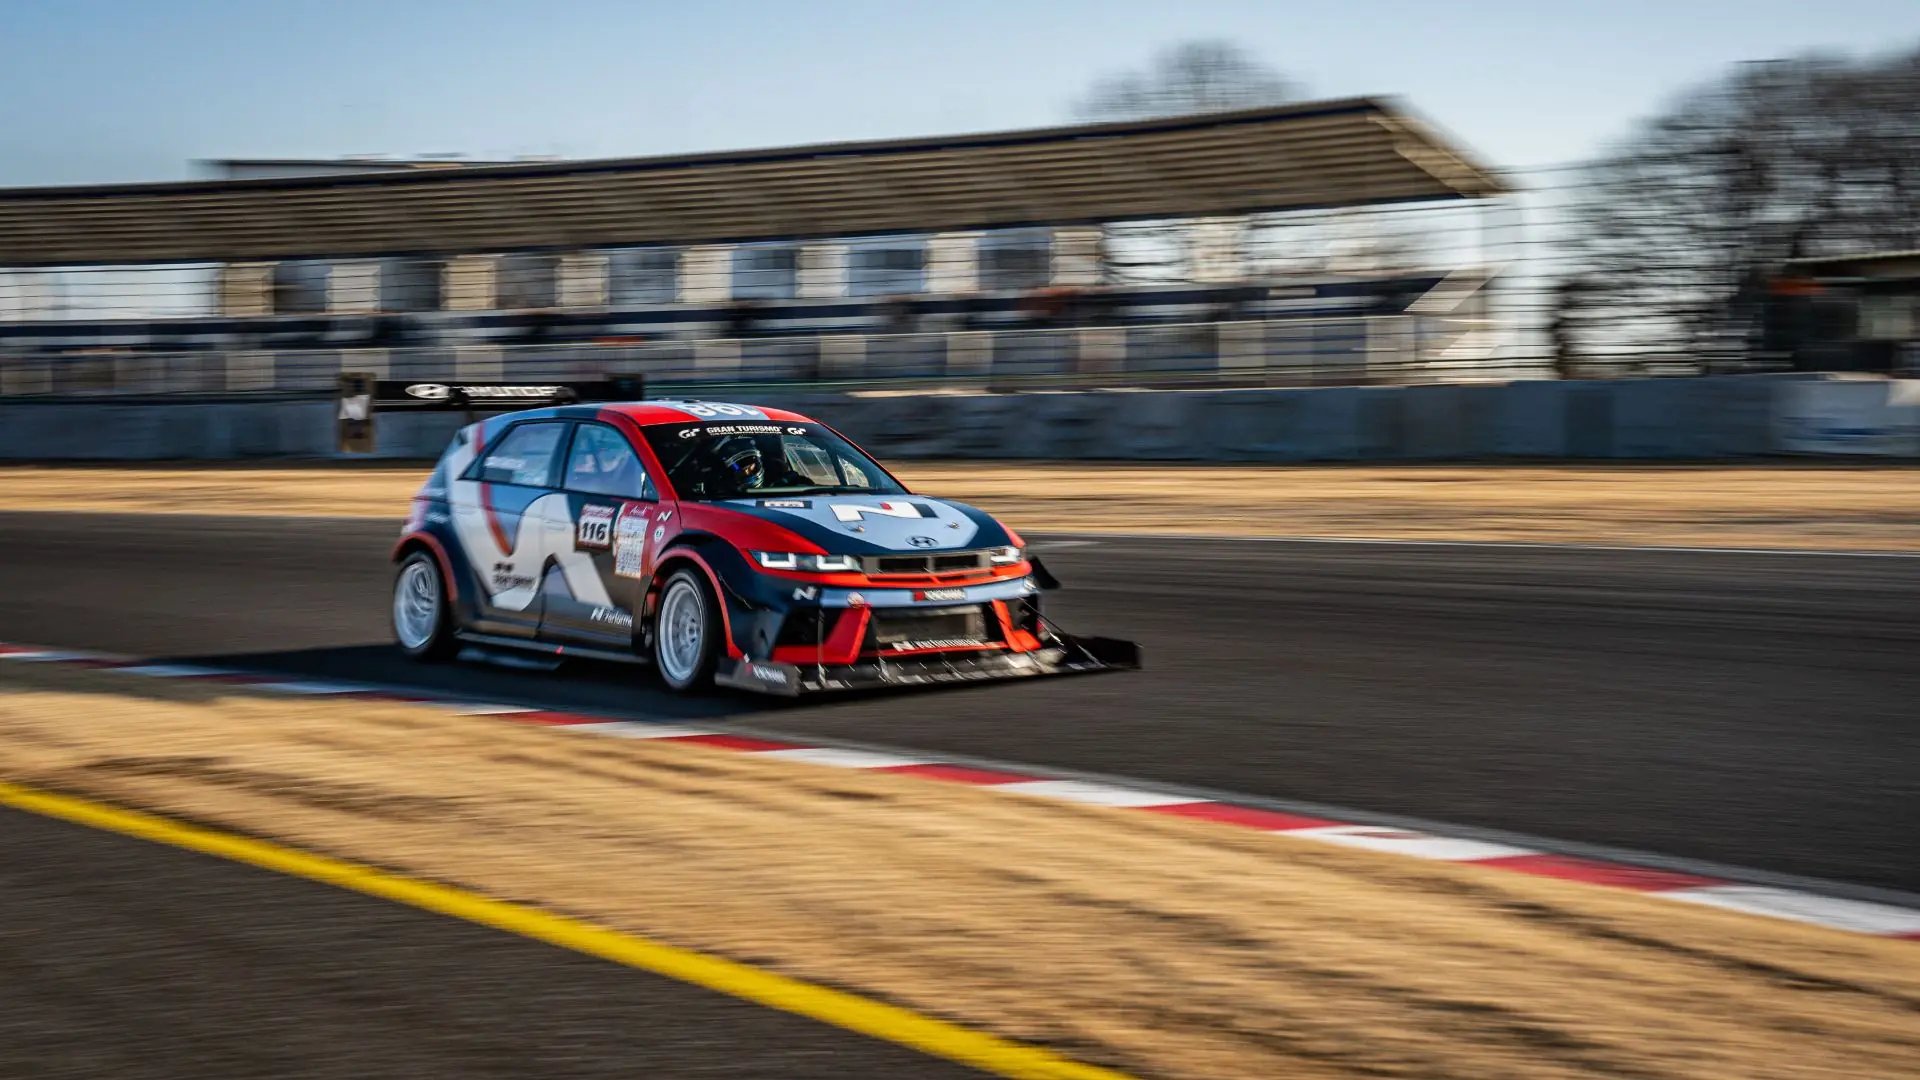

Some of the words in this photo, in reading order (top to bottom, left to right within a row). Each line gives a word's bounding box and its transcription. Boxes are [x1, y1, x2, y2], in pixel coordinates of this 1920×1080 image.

[706, 426, 735, 434] GRAN
[736, 425, 780, 433] TURISMO
[582, 522, 607, 541] 116
